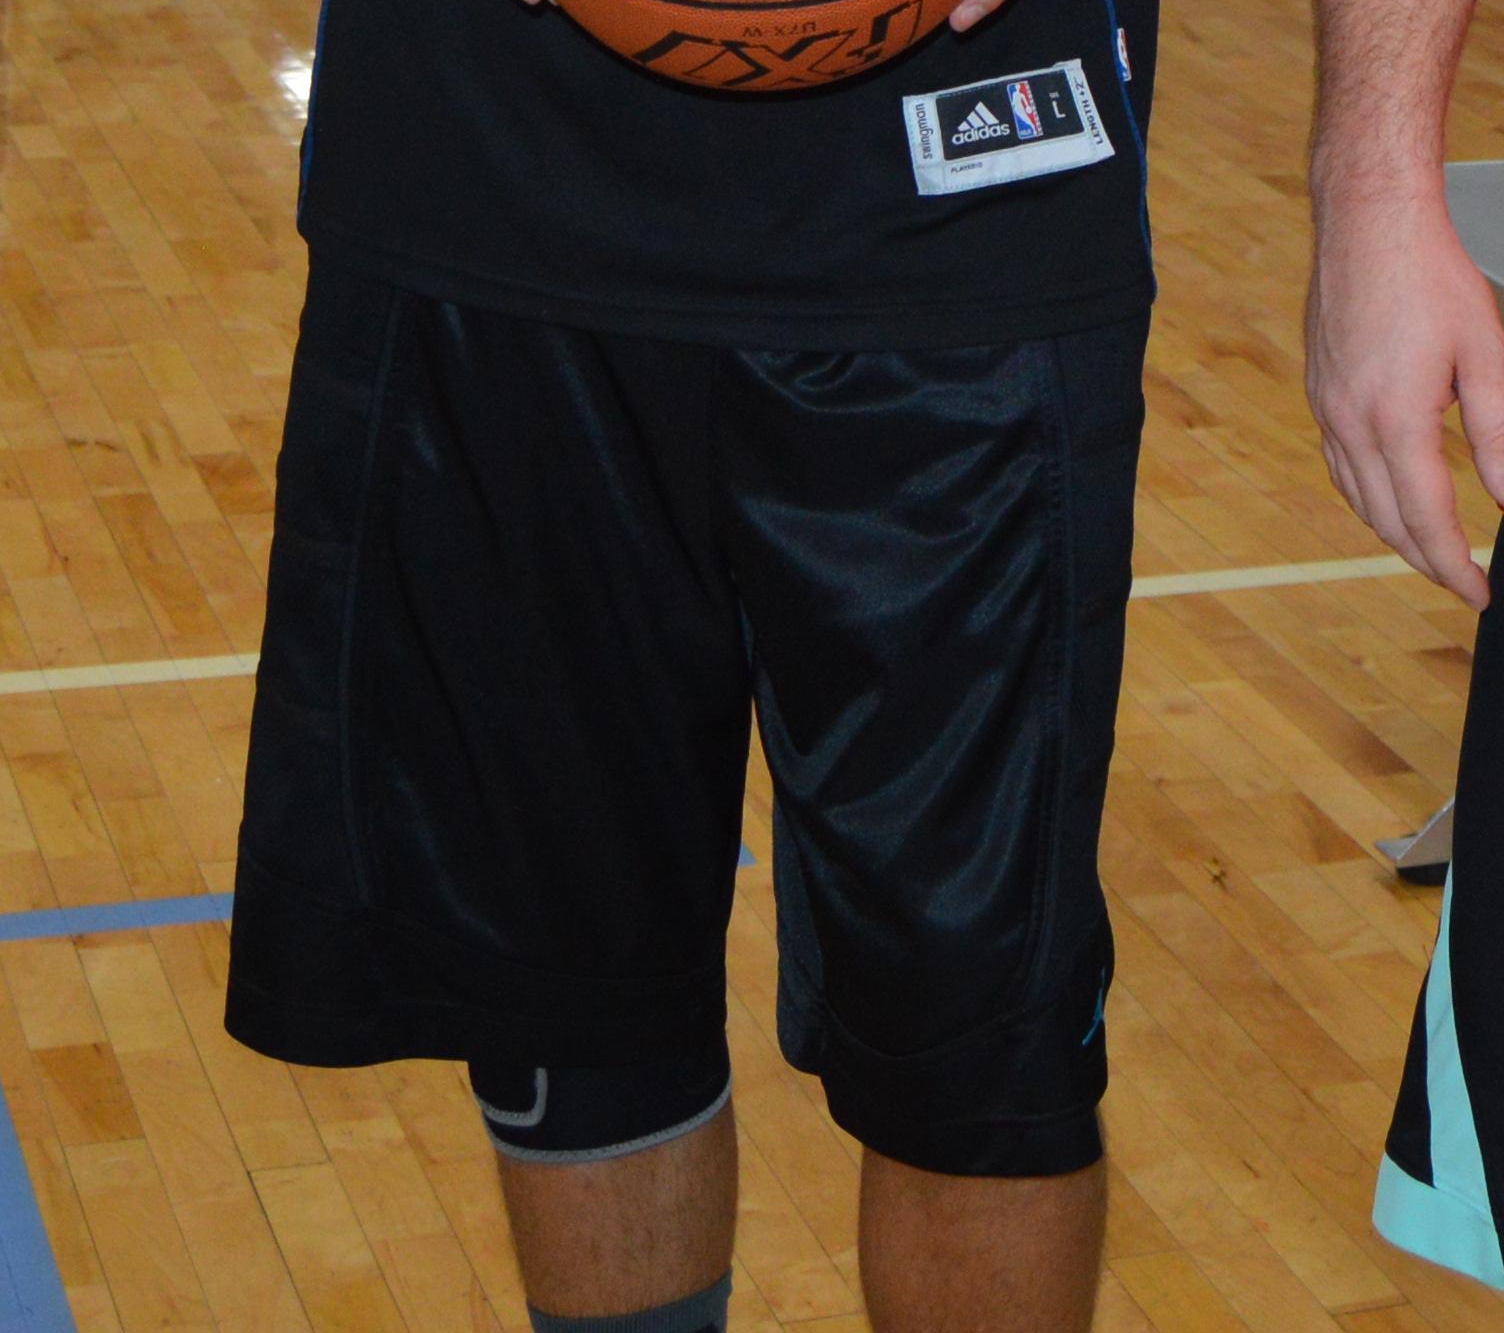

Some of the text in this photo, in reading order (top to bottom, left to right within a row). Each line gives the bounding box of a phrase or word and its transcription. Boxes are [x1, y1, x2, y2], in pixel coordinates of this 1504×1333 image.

[915, 102, 933, 160] swingman
[951, 123, 1011, 145] adidas
[1082, 99, 1104, 145] LENGTH
